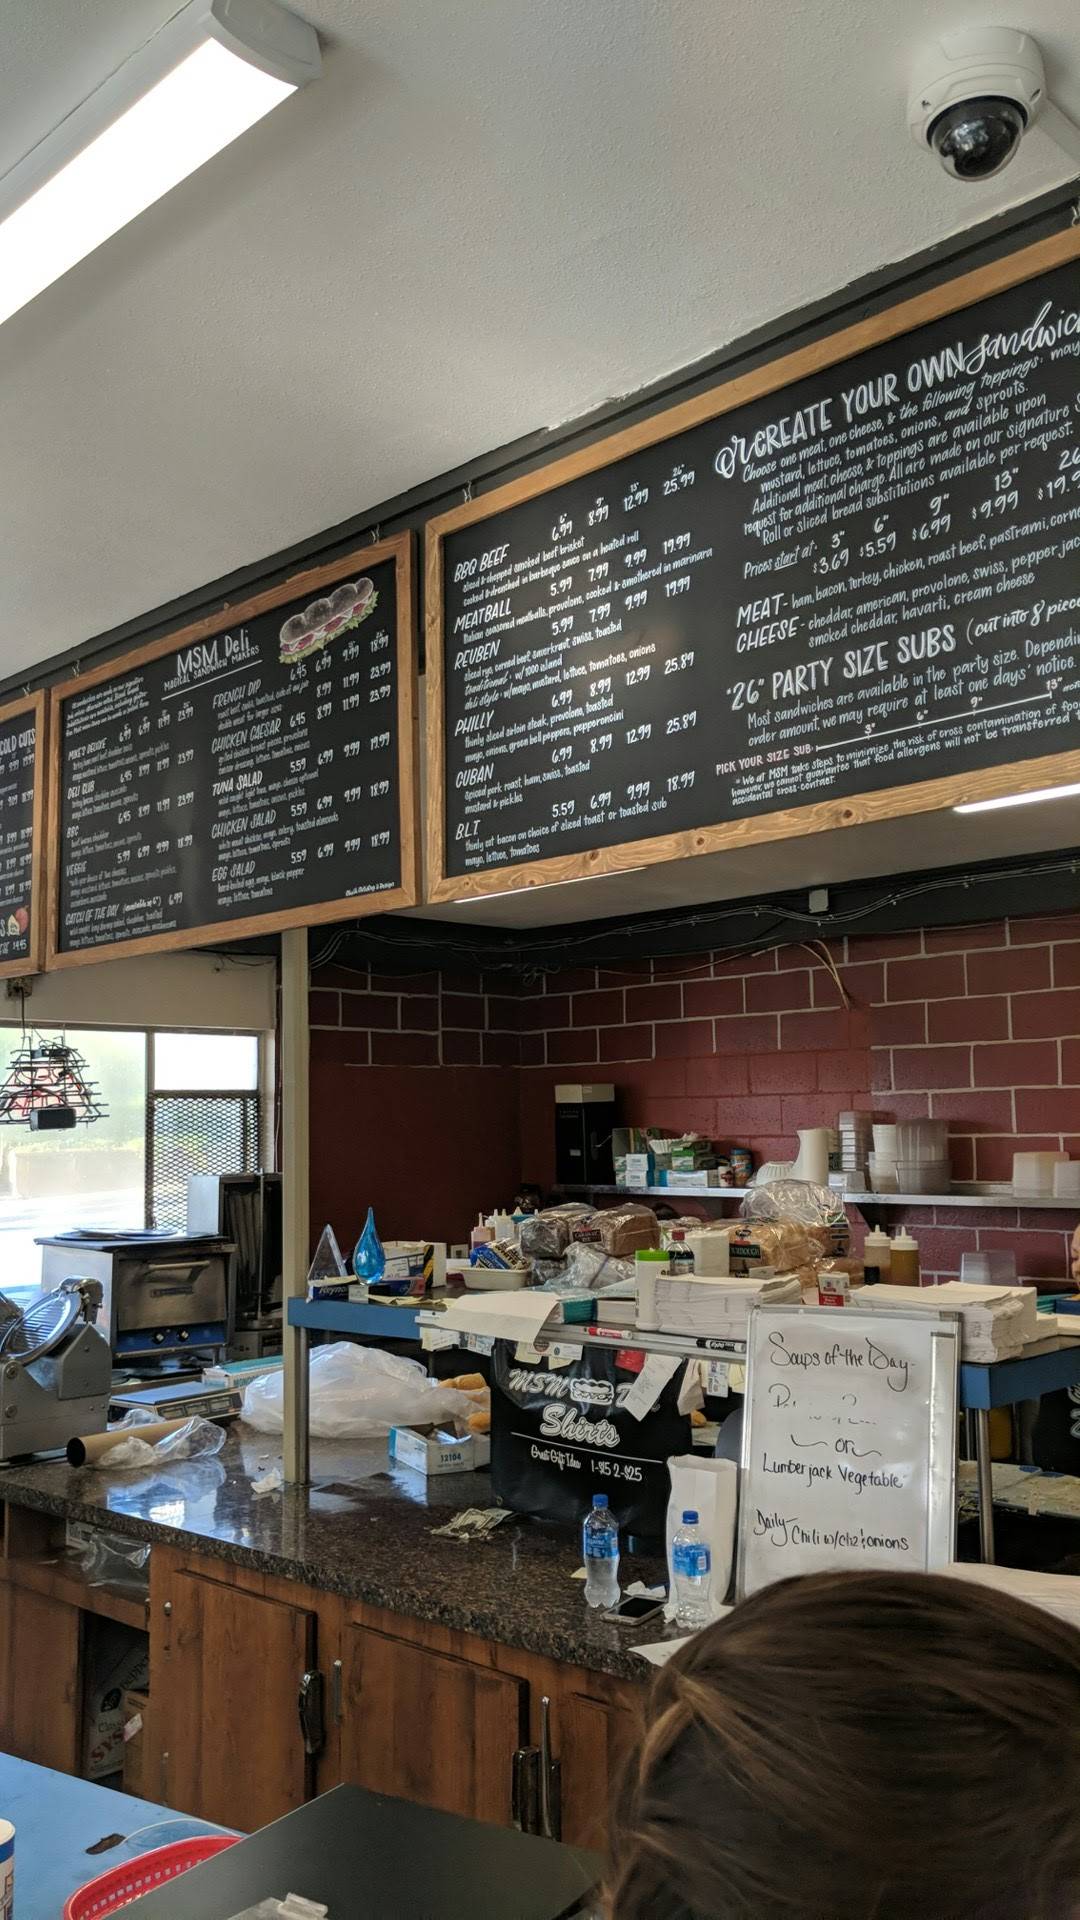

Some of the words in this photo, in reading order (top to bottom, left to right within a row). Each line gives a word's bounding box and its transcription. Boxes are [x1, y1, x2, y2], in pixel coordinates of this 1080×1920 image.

[753, 398, 832, 457] CREATE
[841, 373, 900, 423] YOUR
[965, 301, 1080, 375] sandwic
[742, 460, 777, 483] Choose
[780, 452, 797, 468] one
[829, 432, 847, 448] one
[899, 401, 918, 420] the
[922, 371, 977, 411] following
[944, 396, 973, 421] and
[744, 510, 777, 537] request
[778, 507, 793, 522] for
[794, 483, 846, 515] additional
[887, 462, 903, 482] All
[905, 455, 925, 475] are
[930, 441, 962, 465] made
[1006, 405, 1069, 438] signature
[752, 482, 800, 515] Additional
[876, 439, 924, 469] toppings
[927, 430, 948, 448] are
[952, 404, 1009, 438] available
[1015, 393, 1046, 417] upon
[744, 558, 772, 579] Prices
[774, 544, 799, 571] start
[831, 530, 845, 548] 3"
[874, 514, 889, 533] 6"
[929, 493, 949, 516] 9"
[994, 467, 1019, 491] 13"
[762, 524, 781, 545] Roll
[796, 508, 827, 533] sliced
[832, 494, 863, 520] bread
[865, 474, 935, 508] substitutions
[939, 449, 996, 481] available
[454, 558, 477, 582] BBQ
[479, 543, 510, 572] BEEF
[551, 520, 572, 541] 6.99
[588, 504, 608, 526] 8.99
[623, 488, 648, 511] 12.99
[663, 471, 695, 495] 25.99
[813, 548, 849, 574] $3.69
[860, 531, 896, 557] $5.59
[912, 513, 951, 540] $6.99
[972, 490, 1018, 519] $9.99
[928, 543, 956, 565] roast
[454, 597, 511, 633] MEATBALL
[550, 576, 572, 596] 5.99
[588, 562, 608, 582] 7.99
[624, 548, 647, 568] 9.99
[663, 532, 690, 554] 19.99
[454, 639, 501, 670] REUBEN
[552, 615, 573, 636] 5.99
[588, 602, 610, 623] 7.99
[624, 590, 647, 610] 9.99
[665, 575, 690, 597] 19.99
[772, 657, 833, 700] PARTY
[843, 641, 888, 678] SIZE
[897, 624, 956, 663] SUBS
[1002, 609, 1029, 627] into
[1030, 599, 1048, 626] 8
[164, 675, 191, 692] MAGICAL
[193, 658, 228, 679] SANDWICH
[231, 645, 260, 664] MAKERS
[177, 640, 218, 677] MSM
[224, 629, 250, 660] Deli
[212, 685, 246, 709] FRENCH
[247, 678, 261, 696] DIP
[454, 709, 494, 736] PHILLY
[551, 689, 572, 707] 6.99
[590, 676, 611, 697] 8.99
[626, 664, 650, 685] 12.99
[664, 651, 694, 675] 25.89
[211, 729, 248, 754] CHICKEN
[249, 717, 281, 741] CAESAR
[455, 762, 494, 788] CUBAN
[551, 745, 572, 763] 6.99
[590, 733, 612, 753] 8.99
[626, 723, 651, 744] 12.99
[666, 710, 696, 734] 25.89
[212, 777, 233, 796] TUNA
[236, 770, 263, 791] SALAD
[290, 757, 306, 773] 5.59
[317, 749, 333, 765] 6.99
[343, 741, 360, 757] 9.99
[552, 800, 574, 818] 5.59
[590, 791, 611, 809] 6.99
[627, 781, 650, 800] 9.99
[667, 770, 695, 792] 18.99
[211, 816, 248, 839] CHICKEN
[249, 809, 276, 829] SALAD
[290, 802, 307, 817] 5.59
[316, 795, 332, 810] 6.99
[344, 786, 361, 802] 9.99
[211, 865, 228, 882] EGG
[229, 860, 255, 878] SALAD
[291, 849, 307, 864] 5.59
[317, 843, 334, 858] 6.99
[344, 837, 360, 852] 9.99
[768, 1331, 820, 1370] Soups
[509, 1368, 570, 1398] MSM
[540, 1403, 620, 1448] Shirts
[613, 1463, 643, 1482] 2-$25
[791, 1525, 822, 1546] Chili
